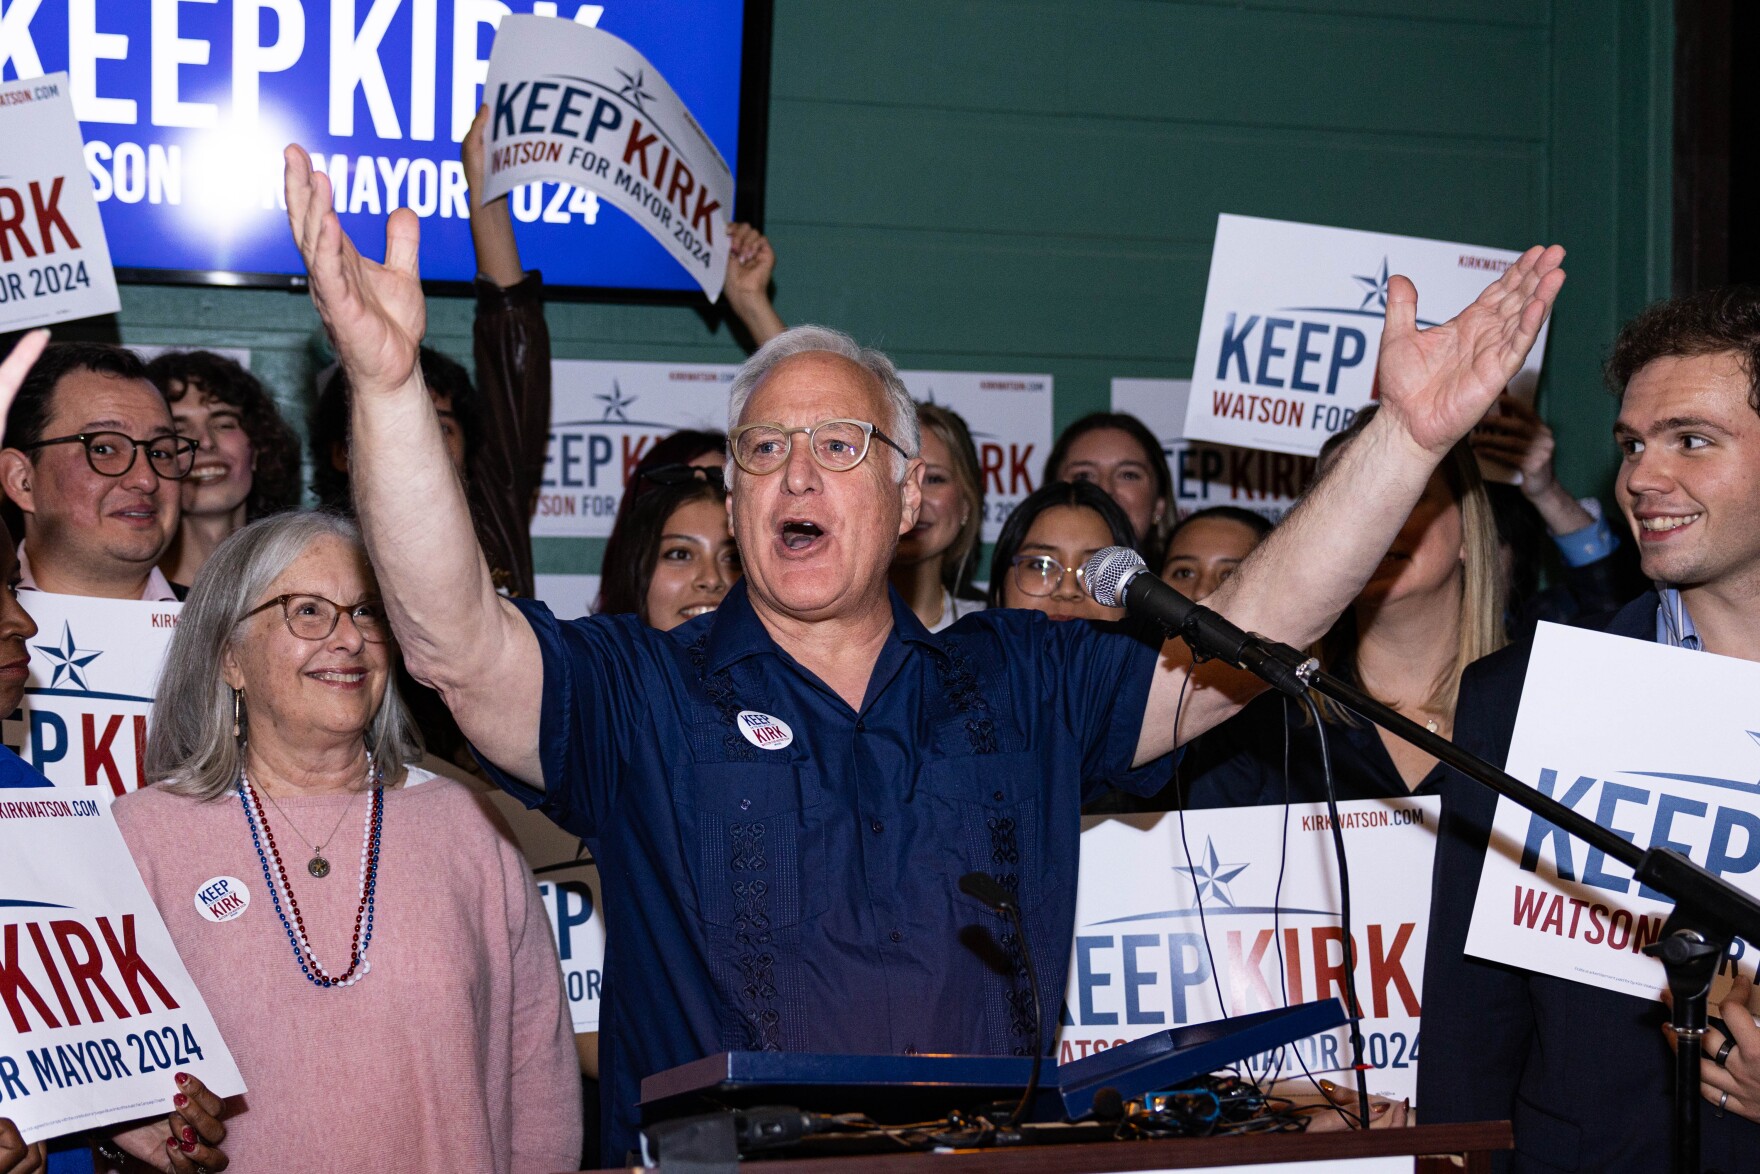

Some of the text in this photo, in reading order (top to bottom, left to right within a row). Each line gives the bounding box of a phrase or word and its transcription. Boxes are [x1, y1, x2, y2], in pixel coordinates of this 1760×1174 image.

[492, 81, 623, 144] KEEP
[311, 152, 471, 219] MAYOR
[568, 147, 610, 179] FOR
[614, 168, 672, 229] MAYOR
[674, 220, 712, 269] 2024
[622, 118, 721, 247] KIRK
[29, 260, 91, 297] 2024
[1216, 311, 1367, 396] KEEP
[1212, 390, 1305, 428] WATSON
[741, 714, 771, 727] KEEP
[752, 725, 787, 743] KIRK
[0, 800, 100, 819] KIRKWATSON.COM
[1302, 808, 1424, 831] KIRKWATSON.COM
[1519, 767, 1760, 905] KEEP
[198, 879, 229, 905] KEEP
[209, 892, 244, 919] KIRK
[1513, 885, 1662, 955] WATSON
[0, 914, 181, 1034] KIRK
[1060, 922, 1422, 1026] EEP KIRK
[26, 1038, 132, 1092] MAYOR
[126, 1023, 204, 1074] 2024
